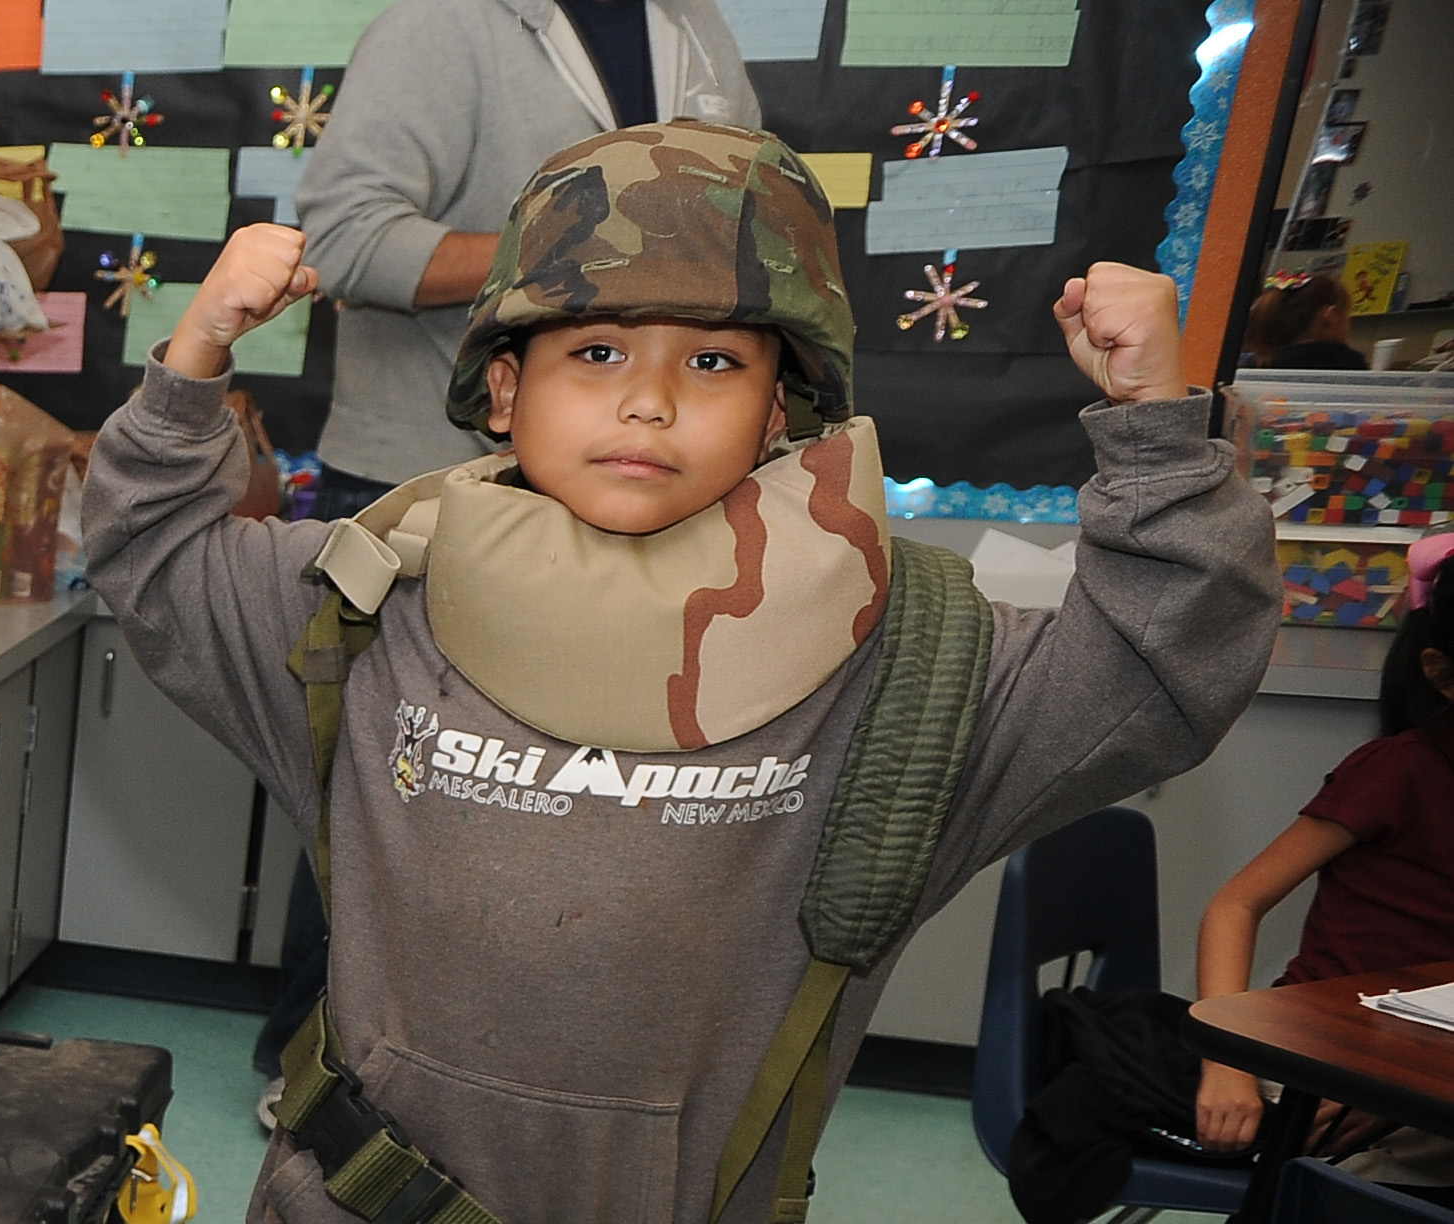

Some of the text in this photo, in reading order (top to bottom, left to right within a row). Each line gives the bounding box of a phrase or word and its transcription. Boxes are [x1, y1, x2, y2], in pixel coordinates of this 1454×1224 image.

[431, 728, 812, 807] Ski Apache
[428, 770, 573, 816] MESCALERO
[660, 789, 805, 826] NEW MEXICO
